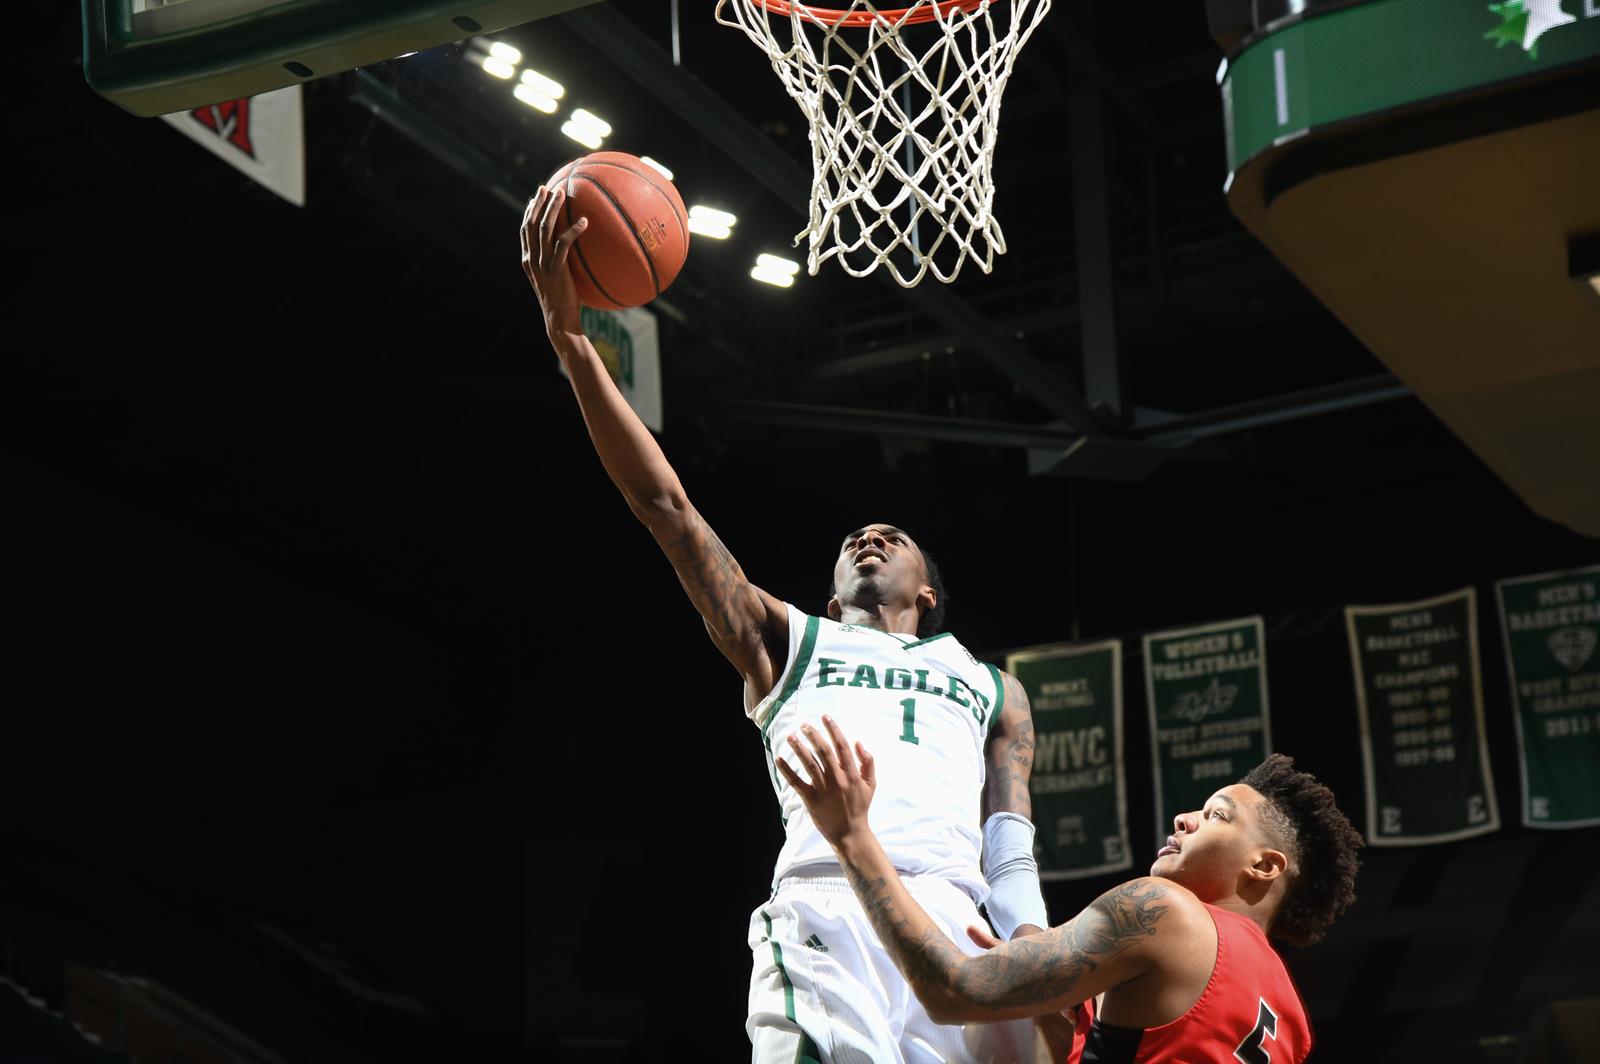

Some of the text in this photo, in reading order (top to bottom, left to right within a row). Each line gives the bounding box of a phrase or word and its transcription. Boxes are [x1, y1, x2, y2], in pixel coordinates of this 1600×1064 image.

[815, 657, 990, 727] EAGLES
[899, 697, 920, 745] 1
[1381, 806, 1402, 834] E
